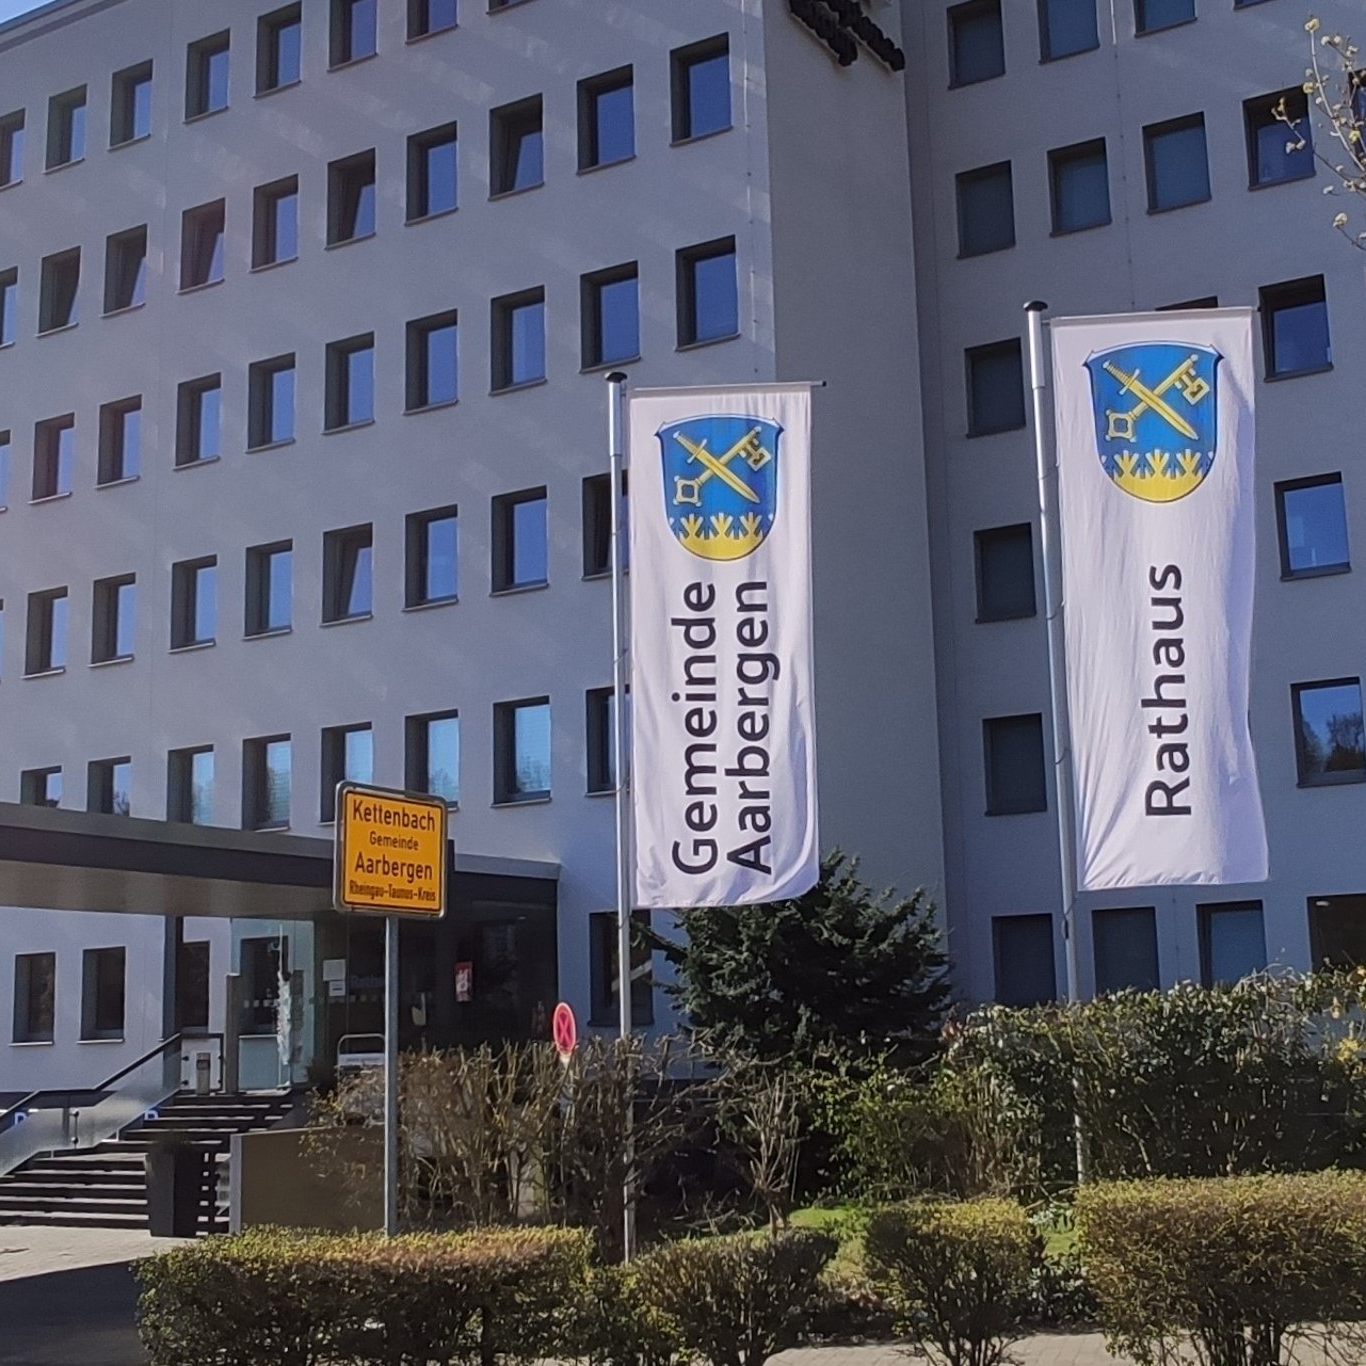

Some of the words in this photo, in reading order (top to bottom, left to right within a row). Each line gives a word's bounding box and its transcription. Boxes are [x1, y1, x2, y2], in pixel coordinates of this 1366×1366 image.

[1141, 564, 1192, 816] Rathaus
[671, 581, 719, 875] Gemeinde
[724, 581, 781, 875] Aarbergen
[353, 799, 435, 832] Kettenbach
[369, 831, 419, 851] Gemeinde
[354, 851, 433, 883] Aarbergen
[349, 879, 436, 902] Rheingau-Taunus-Kreis
